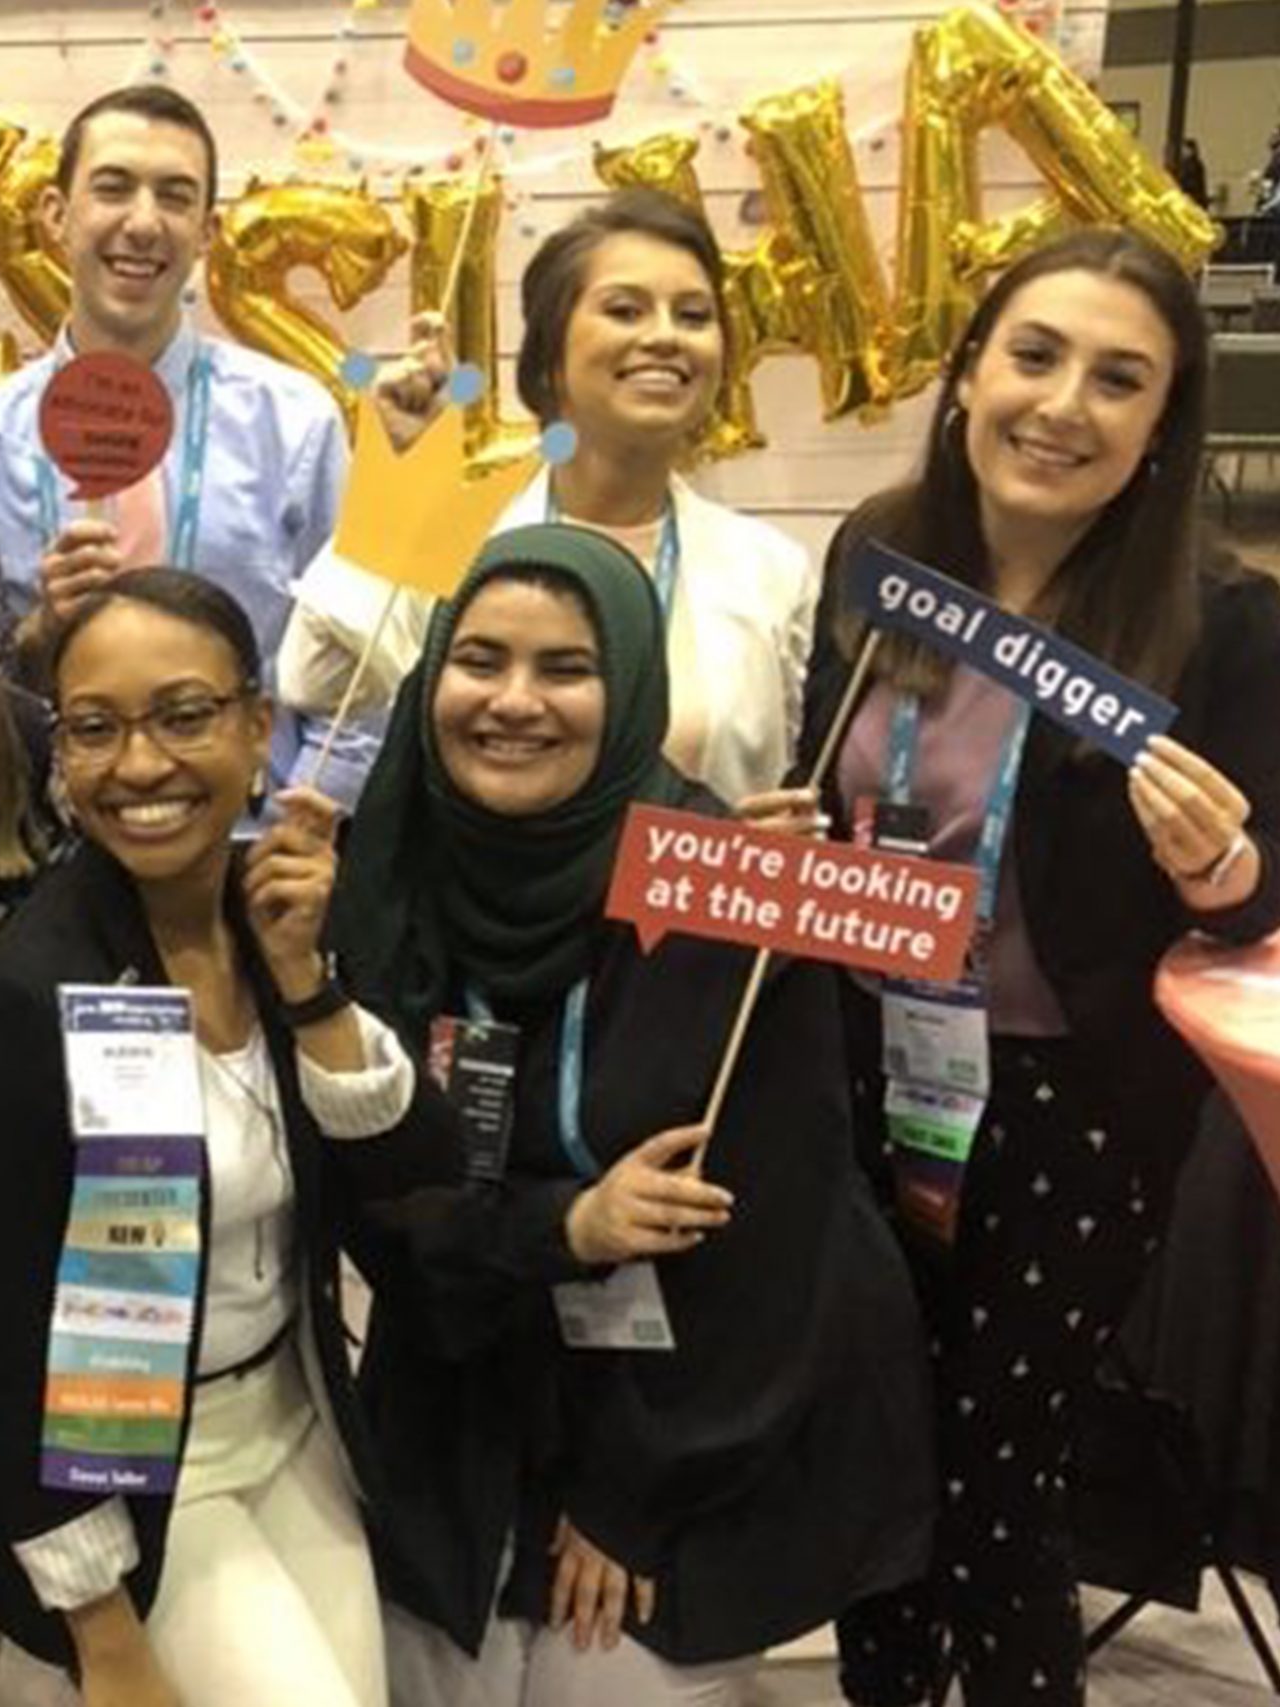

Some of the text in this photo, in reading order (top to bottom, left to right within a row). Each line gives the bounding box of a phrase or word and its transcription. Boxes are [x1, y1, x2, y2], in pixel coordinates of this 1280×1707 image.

[878, 574, 1146, 737] goal digger
[645, 875, 936, 960] at the future
[646, 825, 963, 922] you're looking
